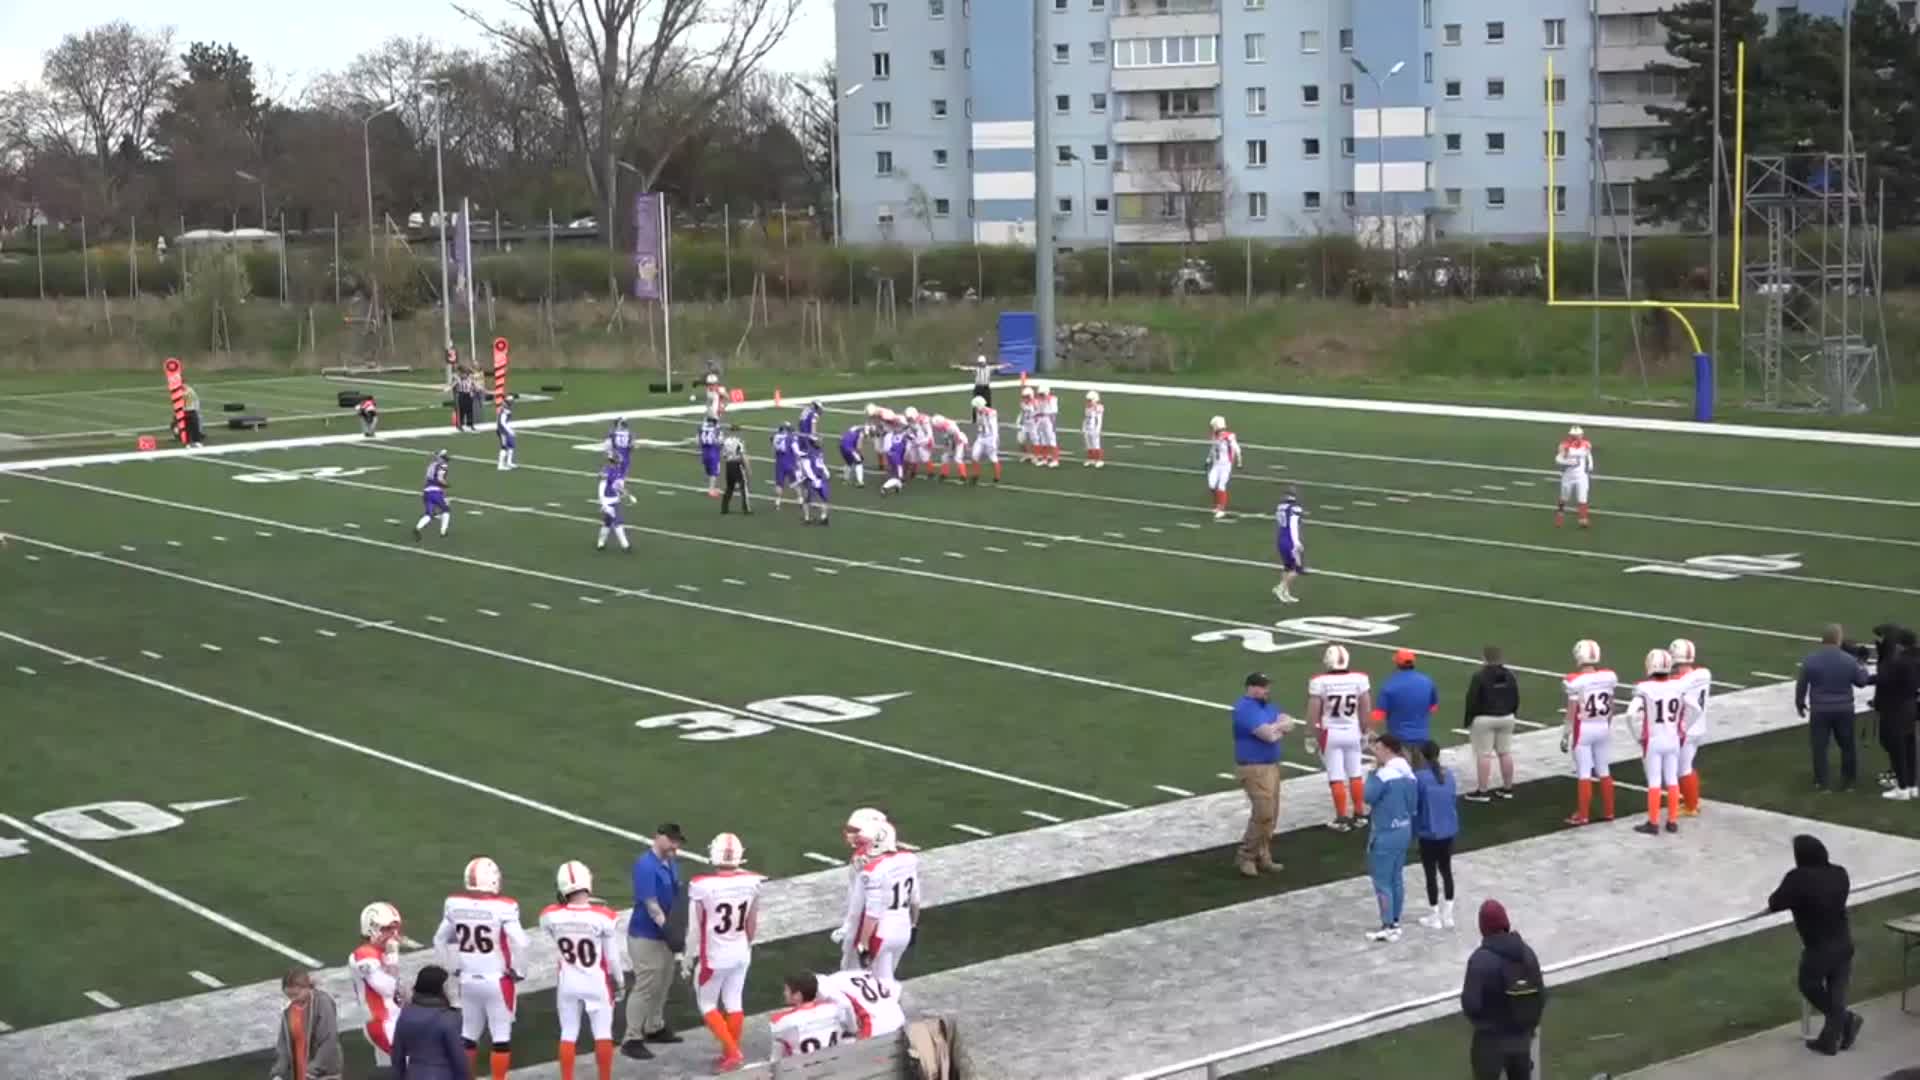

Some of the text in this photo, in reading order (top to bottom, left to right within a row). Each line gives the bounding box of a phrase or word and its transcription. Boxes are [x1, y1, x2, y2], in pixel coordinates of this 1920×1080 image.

[1623, 554, 1803, 580] 10
[1191, 616, 1400, 652] 20
[635, 695, 879, 741] 30
[1328, 695, 1356, 717] 75
[1584, 692, 1610, 718] 43
[1654, 698, 1679, 723] 19
[713, 901, 748, 934] 31
[456, 923, 494, 953] 26
[557, 937, 597, 968] 80
